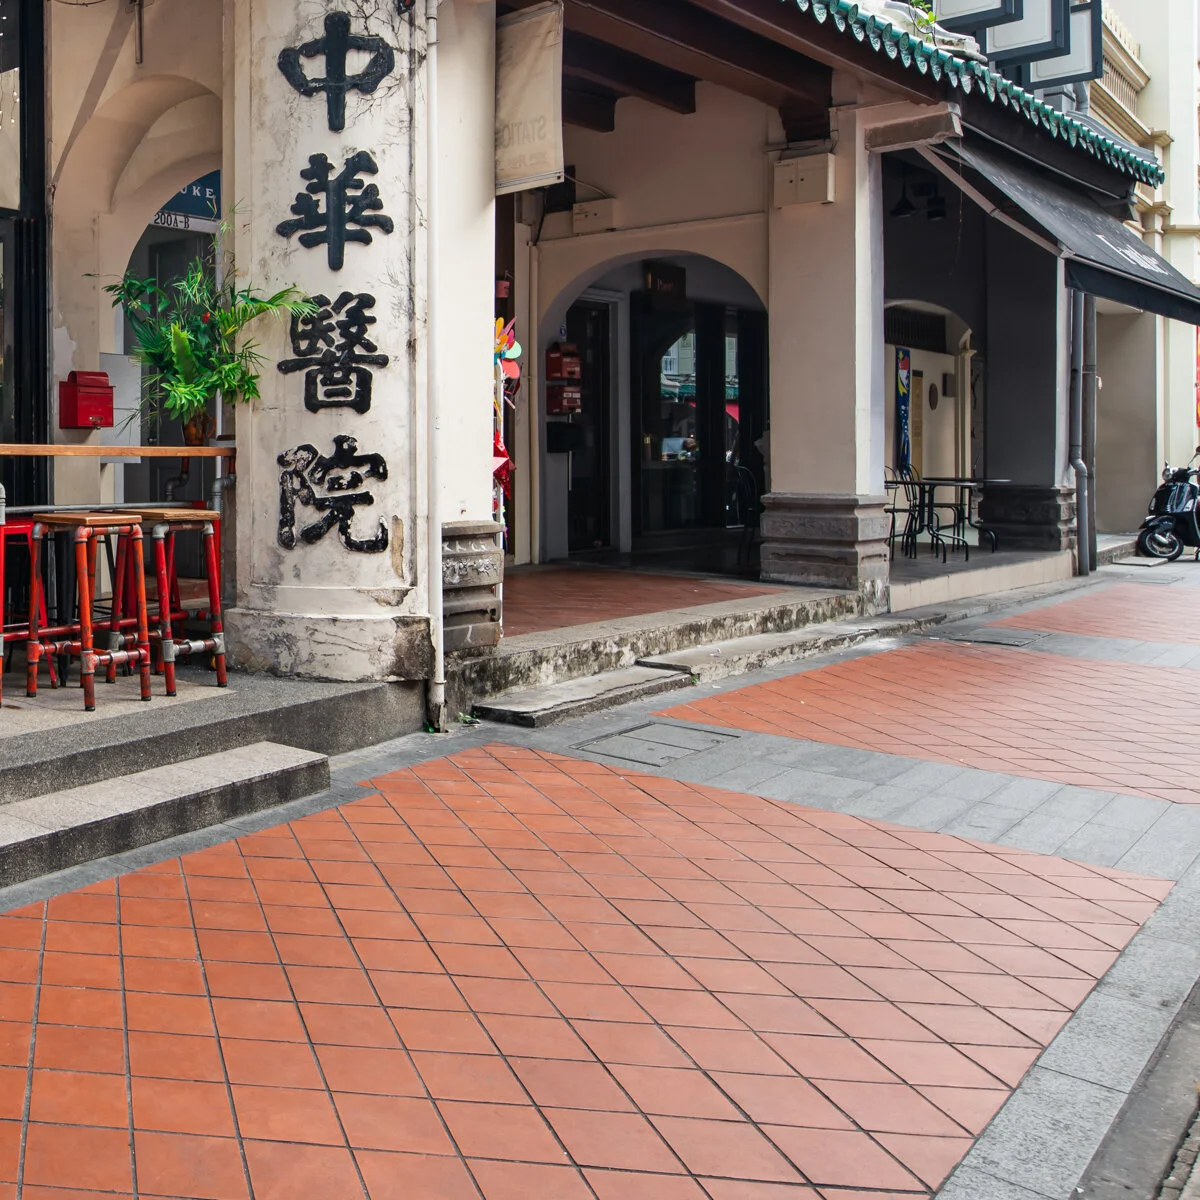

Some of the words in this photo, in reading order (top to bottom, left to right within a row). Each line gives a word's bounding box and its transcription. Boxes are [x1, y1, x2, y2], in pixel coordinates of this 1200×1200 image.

[154, 212, 190, 229] 200A-B
[276, 10, 395, 554] 中華醫院
